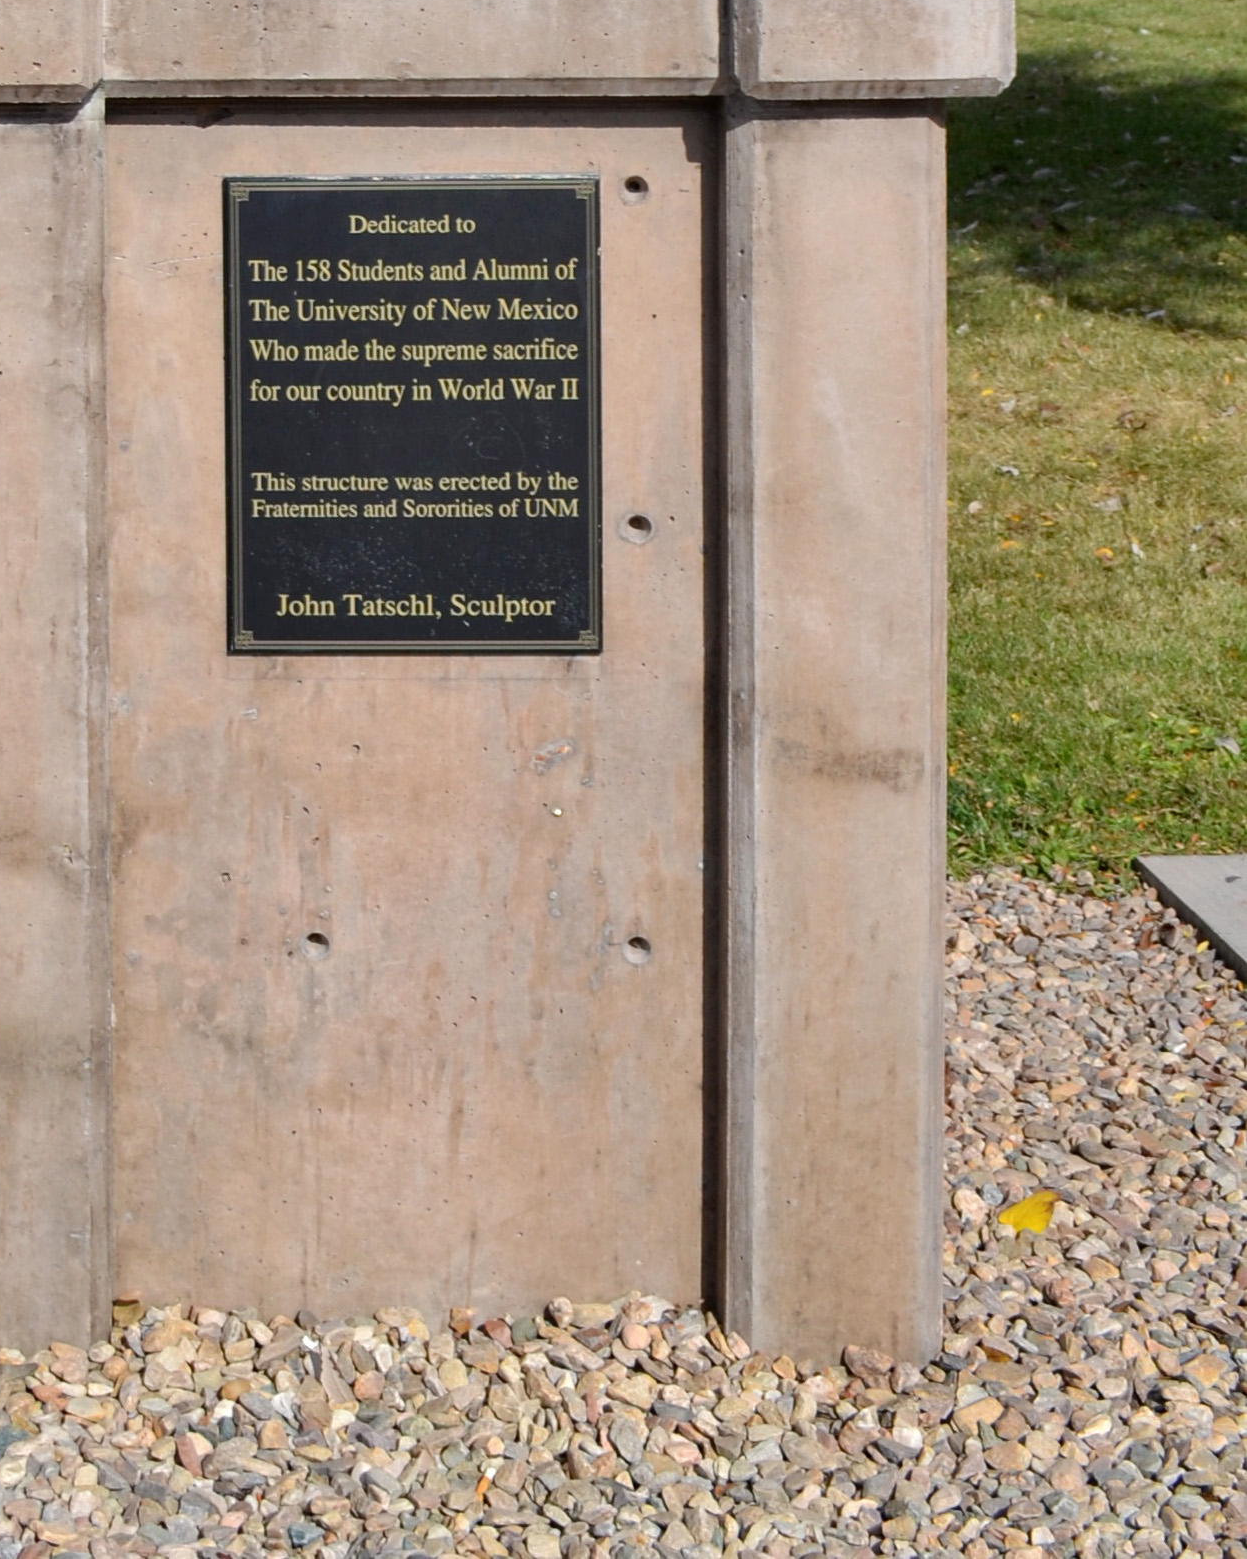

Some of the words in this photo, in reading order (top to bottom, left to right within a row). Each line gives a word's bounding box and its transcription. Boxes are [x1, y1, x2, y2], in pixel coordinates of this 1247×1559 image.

[348, 214, 451, 234] Dedicated
[455, 217, 476, 234] to
[247, 259, 288, 282] The
[296, 258, 332, 282] 158
[337, 258, 425, 282] Students
[429, 258, 467, 282] and
[472, 257, 550, 281] Alumni
[554, 257, 578, 281] of
[248, 299, 290, 322] The
[295, 298, 407, 327] University
[412, 297, 438, 321] of
[440, 298, 492, 321] New
[497, 297, 579, 321] Mexico
[248, 339, 299, 362] Who
[303, 338, 360, 362] made
[364, 338, 396, 361] the
[401, 344, 488, 368] supreme
[493, 337, 579, 361] sacrifice
[249, 378, 282, 402] for
[285, 385, 322, 402] our
[326, 382, 406, 408] country
[411, 379, 433, 401] in
[437, 378, 505, 401] World
[509, 377, 557, 401] War
[561, 377, 579, 400] II
[252, 472, 296, 492] This
[301, 475, 389, 492] structure
[394, 476, 434, 492] was
[438, 471, 512, 491] erected
[516, 471, 542, 496] by
[547, 471, 579, 491] the
[251, 498, 358, 518] Fraternities
[363, 498, 398, 518] and
[403, 498, 494, 518] Sororities
[498, 497, 521, 518] of
[523, 498, 579, 518] UNM
[276, 593, 336, 617] John
[342, 593, 442, 620] Tatschl,
[450, 593, 557, 623] Sculptor
